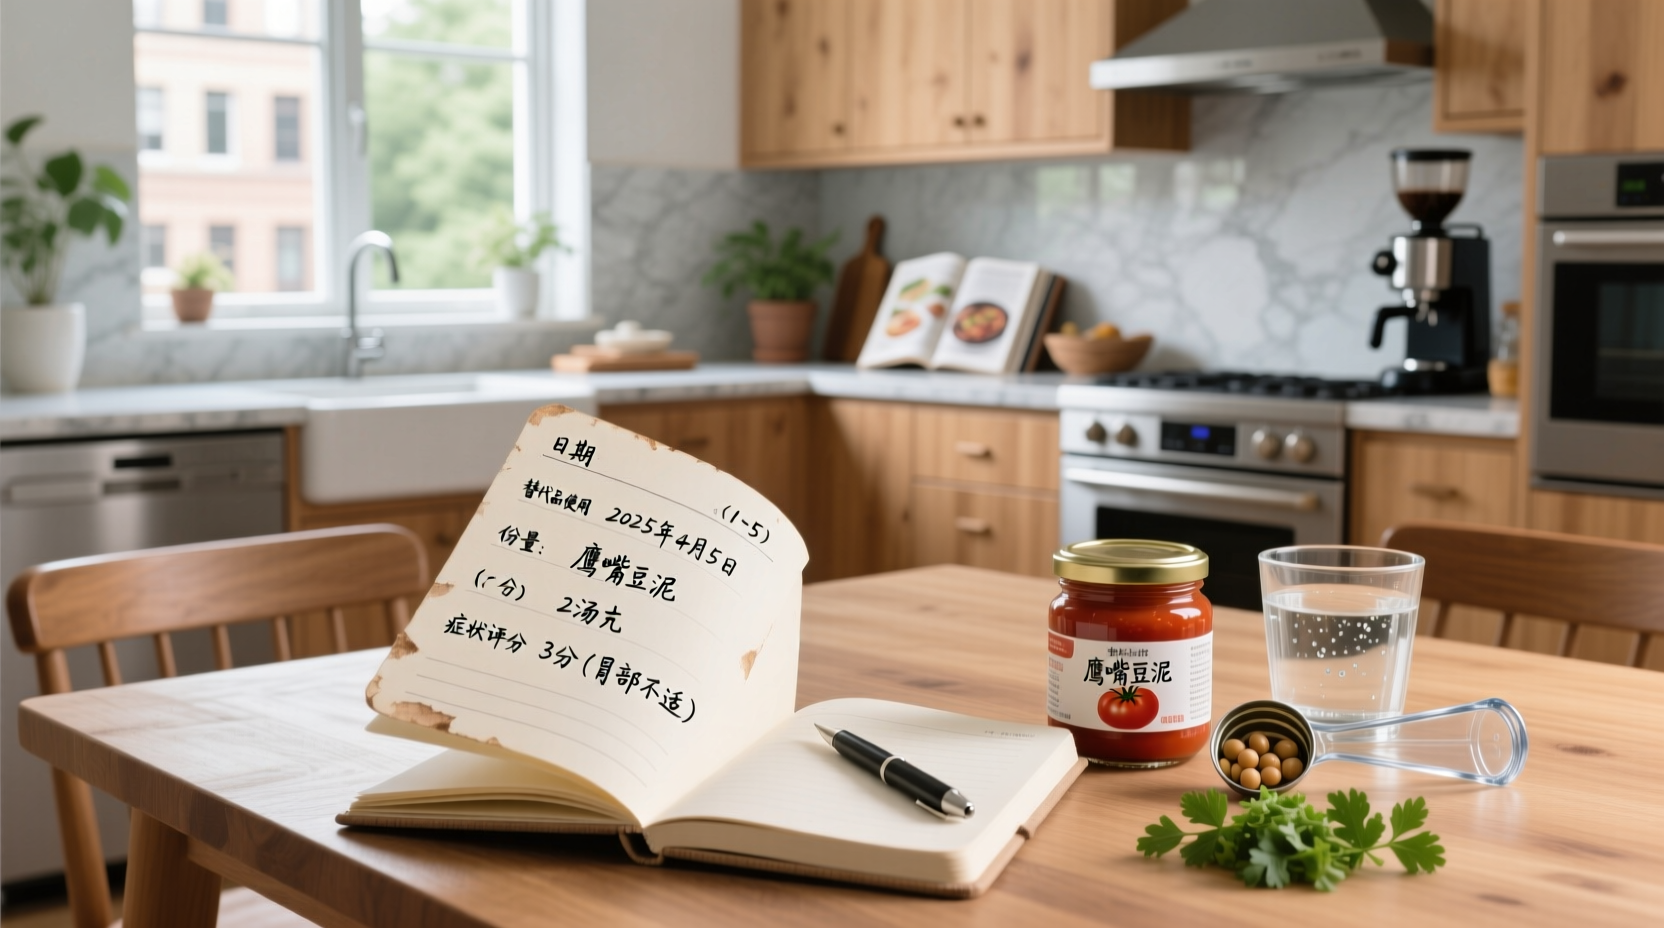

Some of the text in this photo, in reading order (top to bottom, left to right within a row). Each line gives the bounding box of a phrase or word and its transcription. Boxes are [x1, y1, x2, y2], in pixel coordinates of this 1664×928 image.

[553, 436, 771, 545] 日期 (1-5)
[523, 478, 738, 577] 替代品使用 2025年4月5日
[570, 543, 676, 602] 鹰嘴豆泥
[443, 613, 528, 654] 症状评分
[1083, 656, 1173, 686] 鹰嘴豆泥
